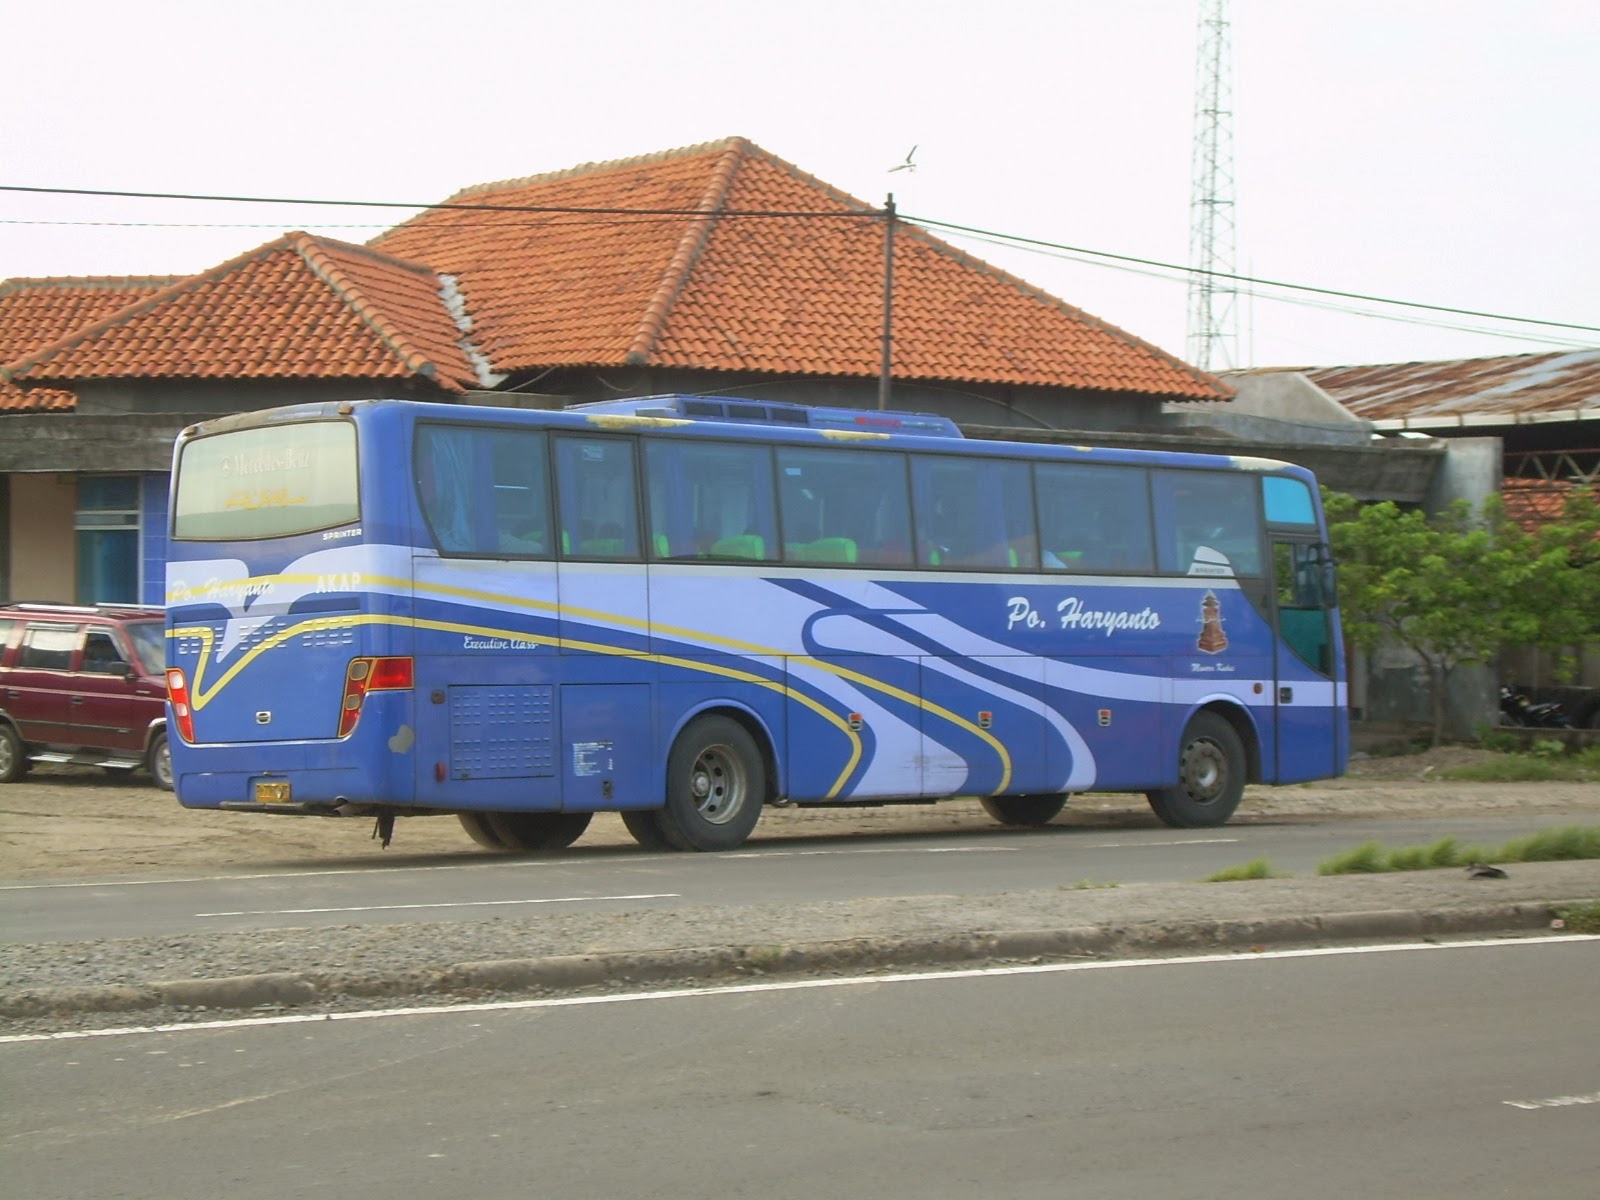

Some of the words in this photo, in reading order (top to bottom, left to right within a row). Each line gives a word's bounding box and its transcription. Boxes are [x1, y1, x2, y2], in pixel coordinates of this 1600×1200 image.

[322, 528, 362, 541] SPRINTER
[315, 572, 361, 593] AKAP
[1007, 596, 1046, 630] Po.
[1057, 596, 1161, 637] Haryanto
[463, 635, 509, 649] Executive
